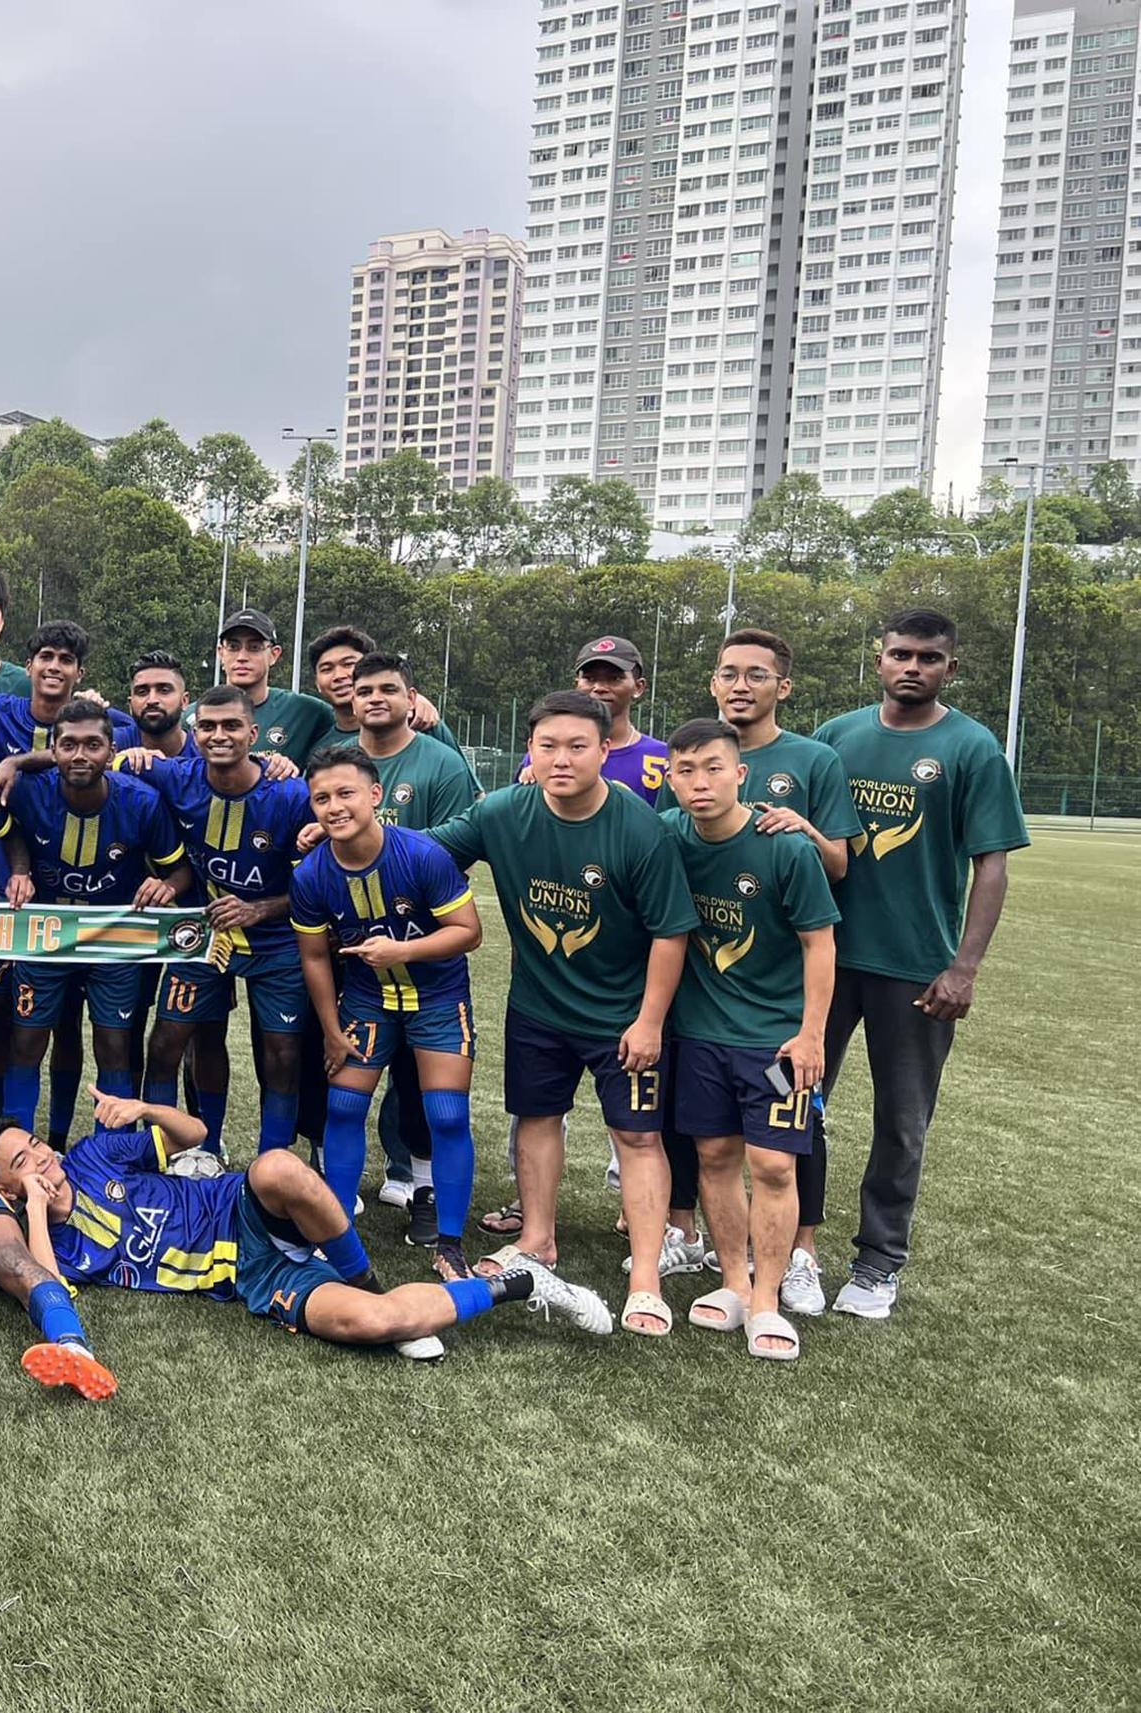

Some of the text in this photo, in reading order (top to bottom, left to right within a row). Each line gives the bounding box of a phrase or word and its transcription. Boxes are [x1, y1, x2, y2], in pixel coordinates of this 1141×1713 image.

[849, 778, 917, 796] WORLDWIDE
[206, 856, 264, 887] GLA
[529, 887, 591, 915] UNION
[693, 894, 743, 911] ORLDWIDE
[697, 902, 743, 926] NION
[26, 915, 62, 952] FC
[369, 920, 425, 942] LA
[17, 983, 35, 1017] 8
[166, 975, 197, 1013] 10
[627, 1070, 660, 1112] 13
[768, 1088, 811, 1131] 20
[125, 1206, 166, 1263] GLA
